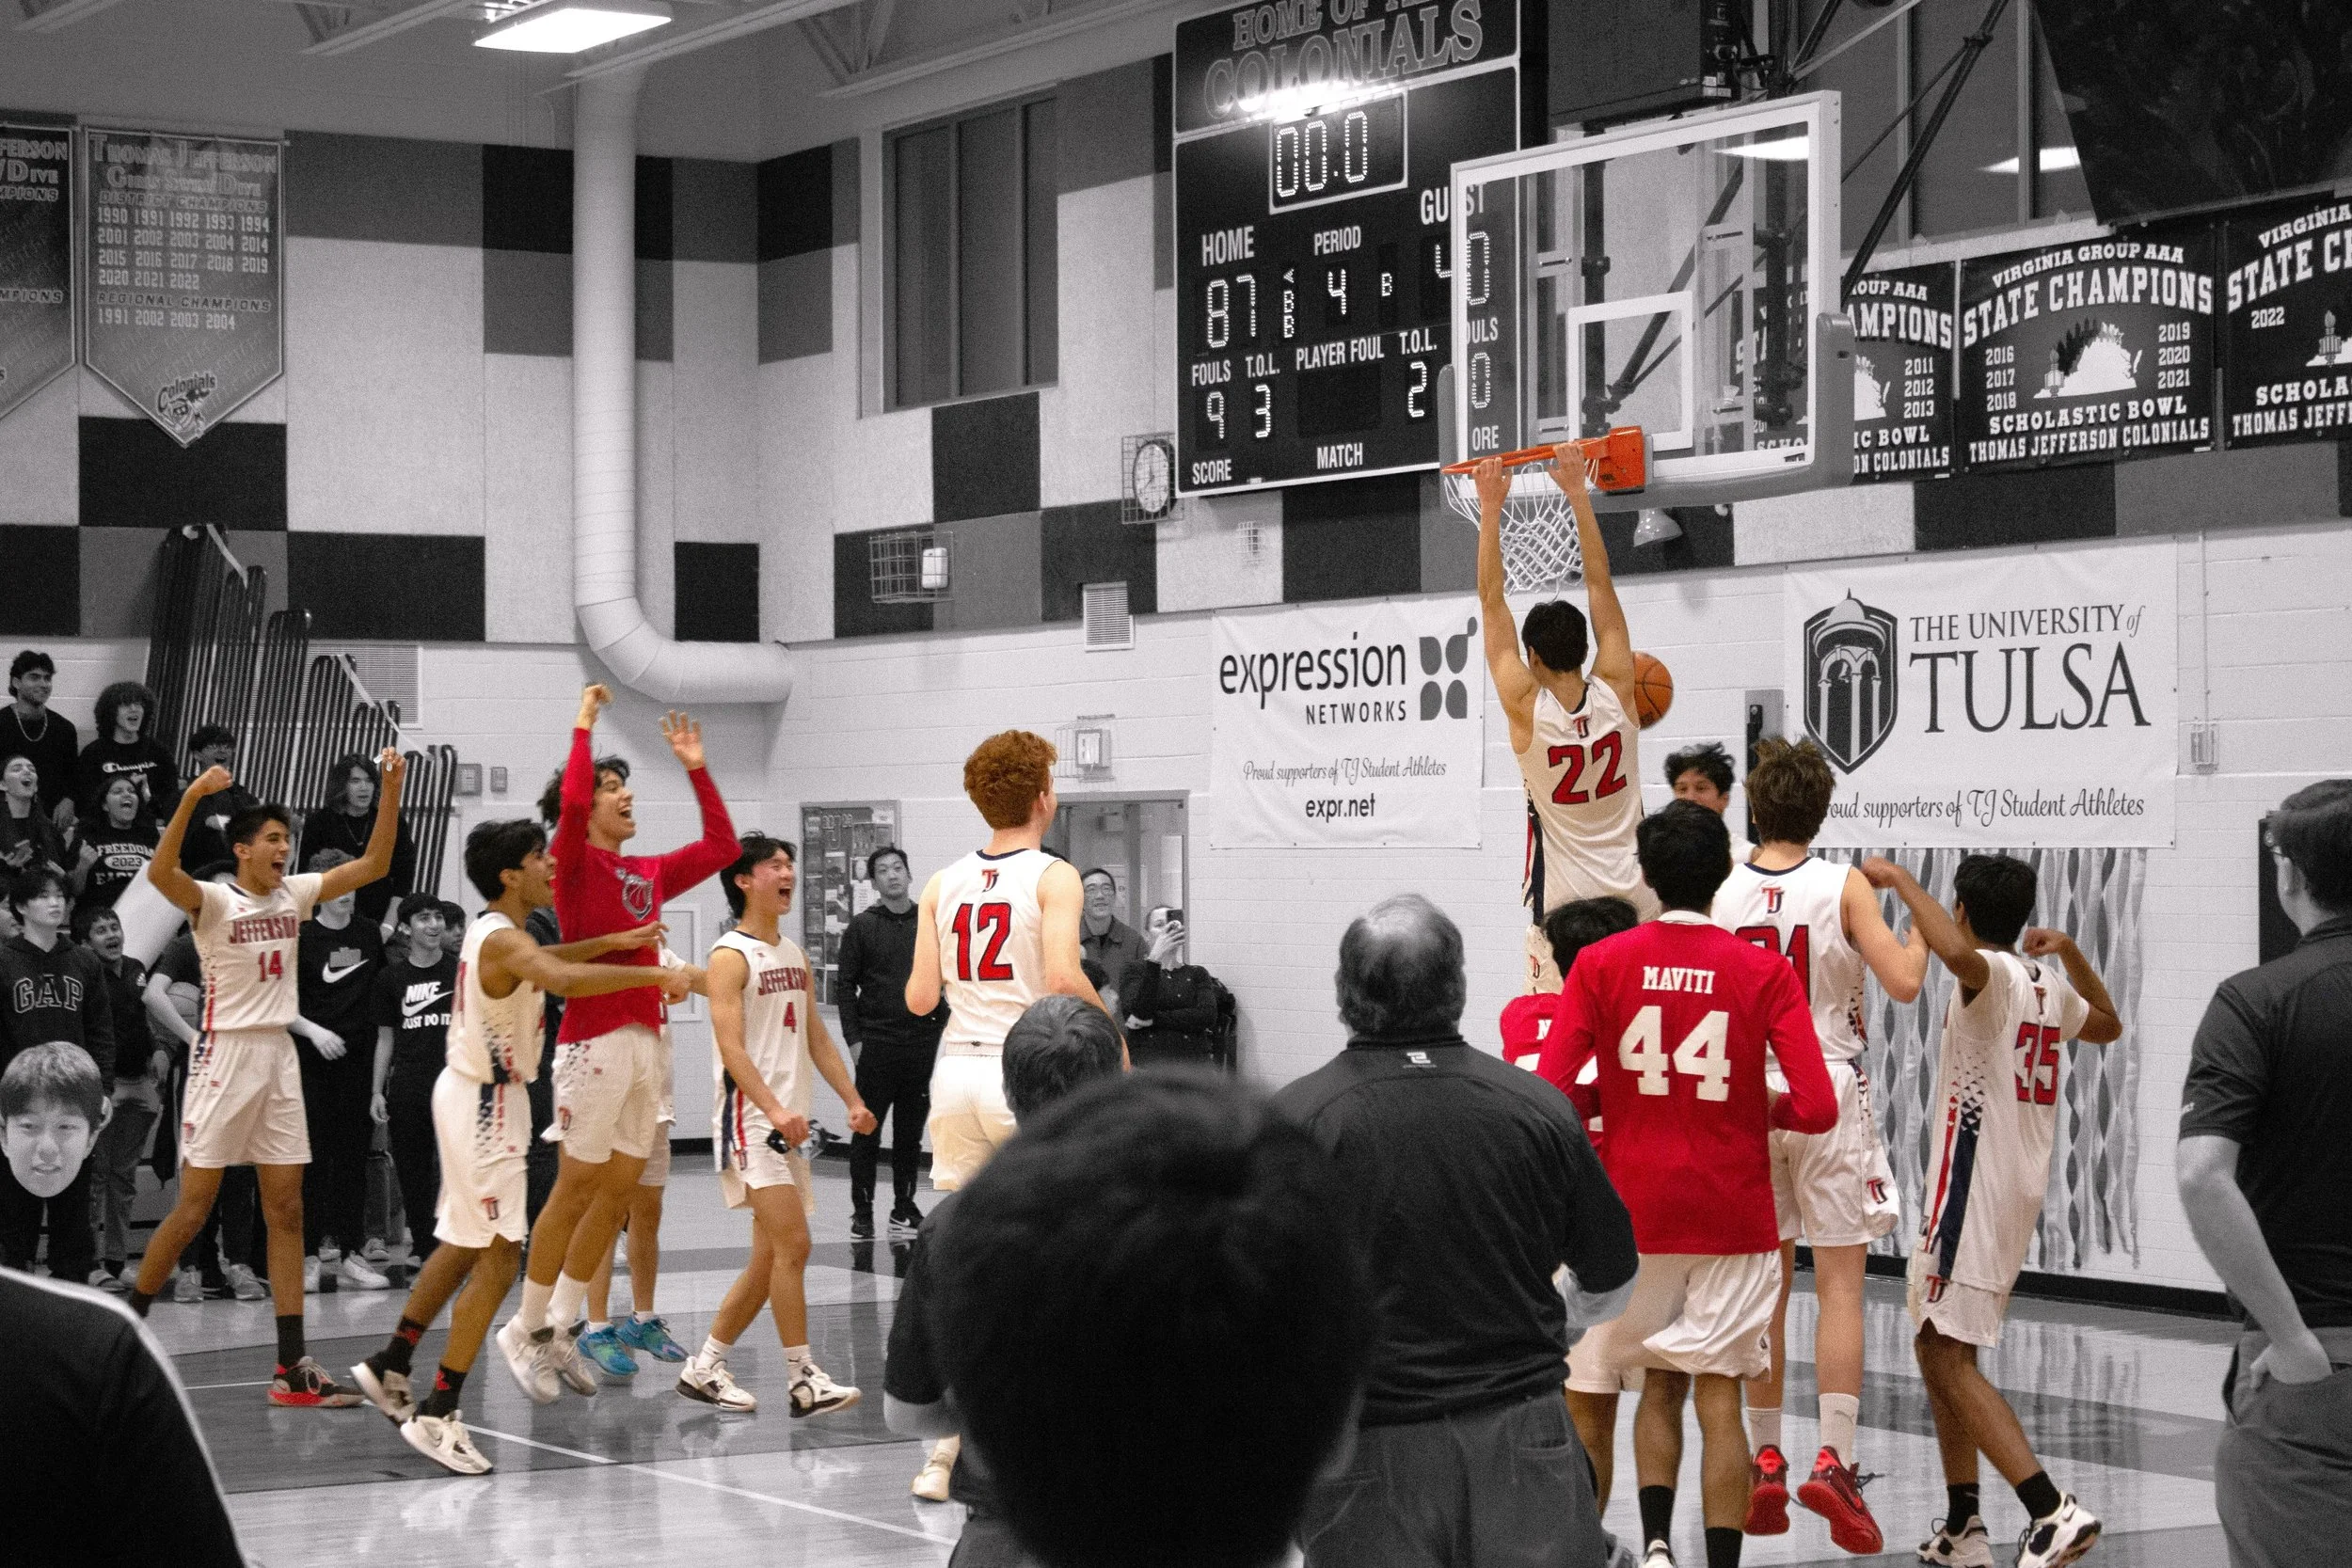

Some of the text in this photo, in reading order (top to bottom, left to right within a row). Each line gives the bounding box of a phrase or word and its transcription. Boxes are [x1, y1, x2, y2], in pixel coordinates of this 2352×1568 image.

[1233, 0, 1322, 51] HOME
[1204, 0, 1483, 119] COLONIALS
[1420, 182, 1488, 225] GUST
[135, 209, 164, 227] 1991
[169, 211, 199, 230] 1992
[205, 213, 235, 231] 1993
[240, 215, 270, 233] 1994
[2258, 203, 2352, 249] VIRGINIA
[1201, 225, 1255, 267] HOME
[1313, 225, 1362, 256] PERIOD
[1992, 242, 2185, 289] VIRGINIA GROUP AAA
[2227, 239, 2315, 314] STATE
[97, 292, 272, 313] REGIONAL CHAMPIONS
[1327, 268, 1346, 315] 4
[1893, 280, 1928, 301] AAA
[98, 308, 129, 325] 1991
[1207, 274, 1257, 348] 87
[1963, 266, 2214, 349] STATE CHAMPIONS
[2251, 307, 2285, 329] 2022
[1399, 327, 1438, 356] T.O.L.
[1467, 317, 1499, 344] OULS
[2157, 321, 2191, 343] 2019
[1245, 354, 1280, 378] T.O.L.
[1295, 336, 1385, 372] PLAYER FOUL
[1904, 356, 1934, 376] 2011
[1985, 344, 2015, 366] 2016
[2157, 345, 2191, 366] 2020
[1191, 359, 1232, 387] FOULS
[1904, 378, 1934, 398] 2012
[1985, 368, 2015, 389] 2017
[2157, 369, 2191, 389] 2021
[1407, 360, 1427, 419] 2
[1986, 391, 2017, 413] 2018
[1207, 390, 1225, 439] 9
[1255, 384, 1271, 438] 3
[1904, 400, 1934, 419] 2013
[1989, 396, 2187, 436] SCHOLASTIC BOWL
[2232, 408, 2298, 437] THOMAS
[1316, 425, 1500, 470] MATCH ORE
[1879, 424, 1931, 446] BOWL
[1968, 417, 2211, 465] THOMAS JEFFERSON COLONIALS
[1191, 458, 1232, 485] SCORE
[1873, 446, 1950, 473] COLONIALS
[1910, 603, 2146, 642] THE UNIVERSITY of
[1219, 631, 1406, 710] expression
[1908, 641, 2152, 734] TULSA
[1305, 700, 1406, 725] NETWORKS
[1242, 760, 1275, 781] Proud
[1276, 762, 1327, 787] supporters
[1327, 757, 1339, 785] of
[1362, 755, 1401, 779] Student
[1402, 754, 1447, 778] Athletes
[1547, 730, 1628, 805] 22
[1305, 793, 1376, 824] expr.net
[1826, 792, 1859, 820] roud
[1863, 794, 1944, 829] supporters
[1945, 790, 1964, 827] of
[2000, 788, 2066, 818] Student
[2069, 786, 2145, 818] Athletes
[229, 915, 297, 945] JEFFERSO
[951, 901, 1014, 982] 12
[258, 949, 284, 982] 14
[1642, 965, 1716, 995] MAVITI
[13, 974, 84, 1014] GAP
[405, 981, 442, 1004] NIKE
[402, 1013, 453, 1030] JUST DO IT
[783, 1001, 797, 1034] 4
[1617, 1005, 1732, 1103] 44
[2014, 1021, 2061, 1105] 35
